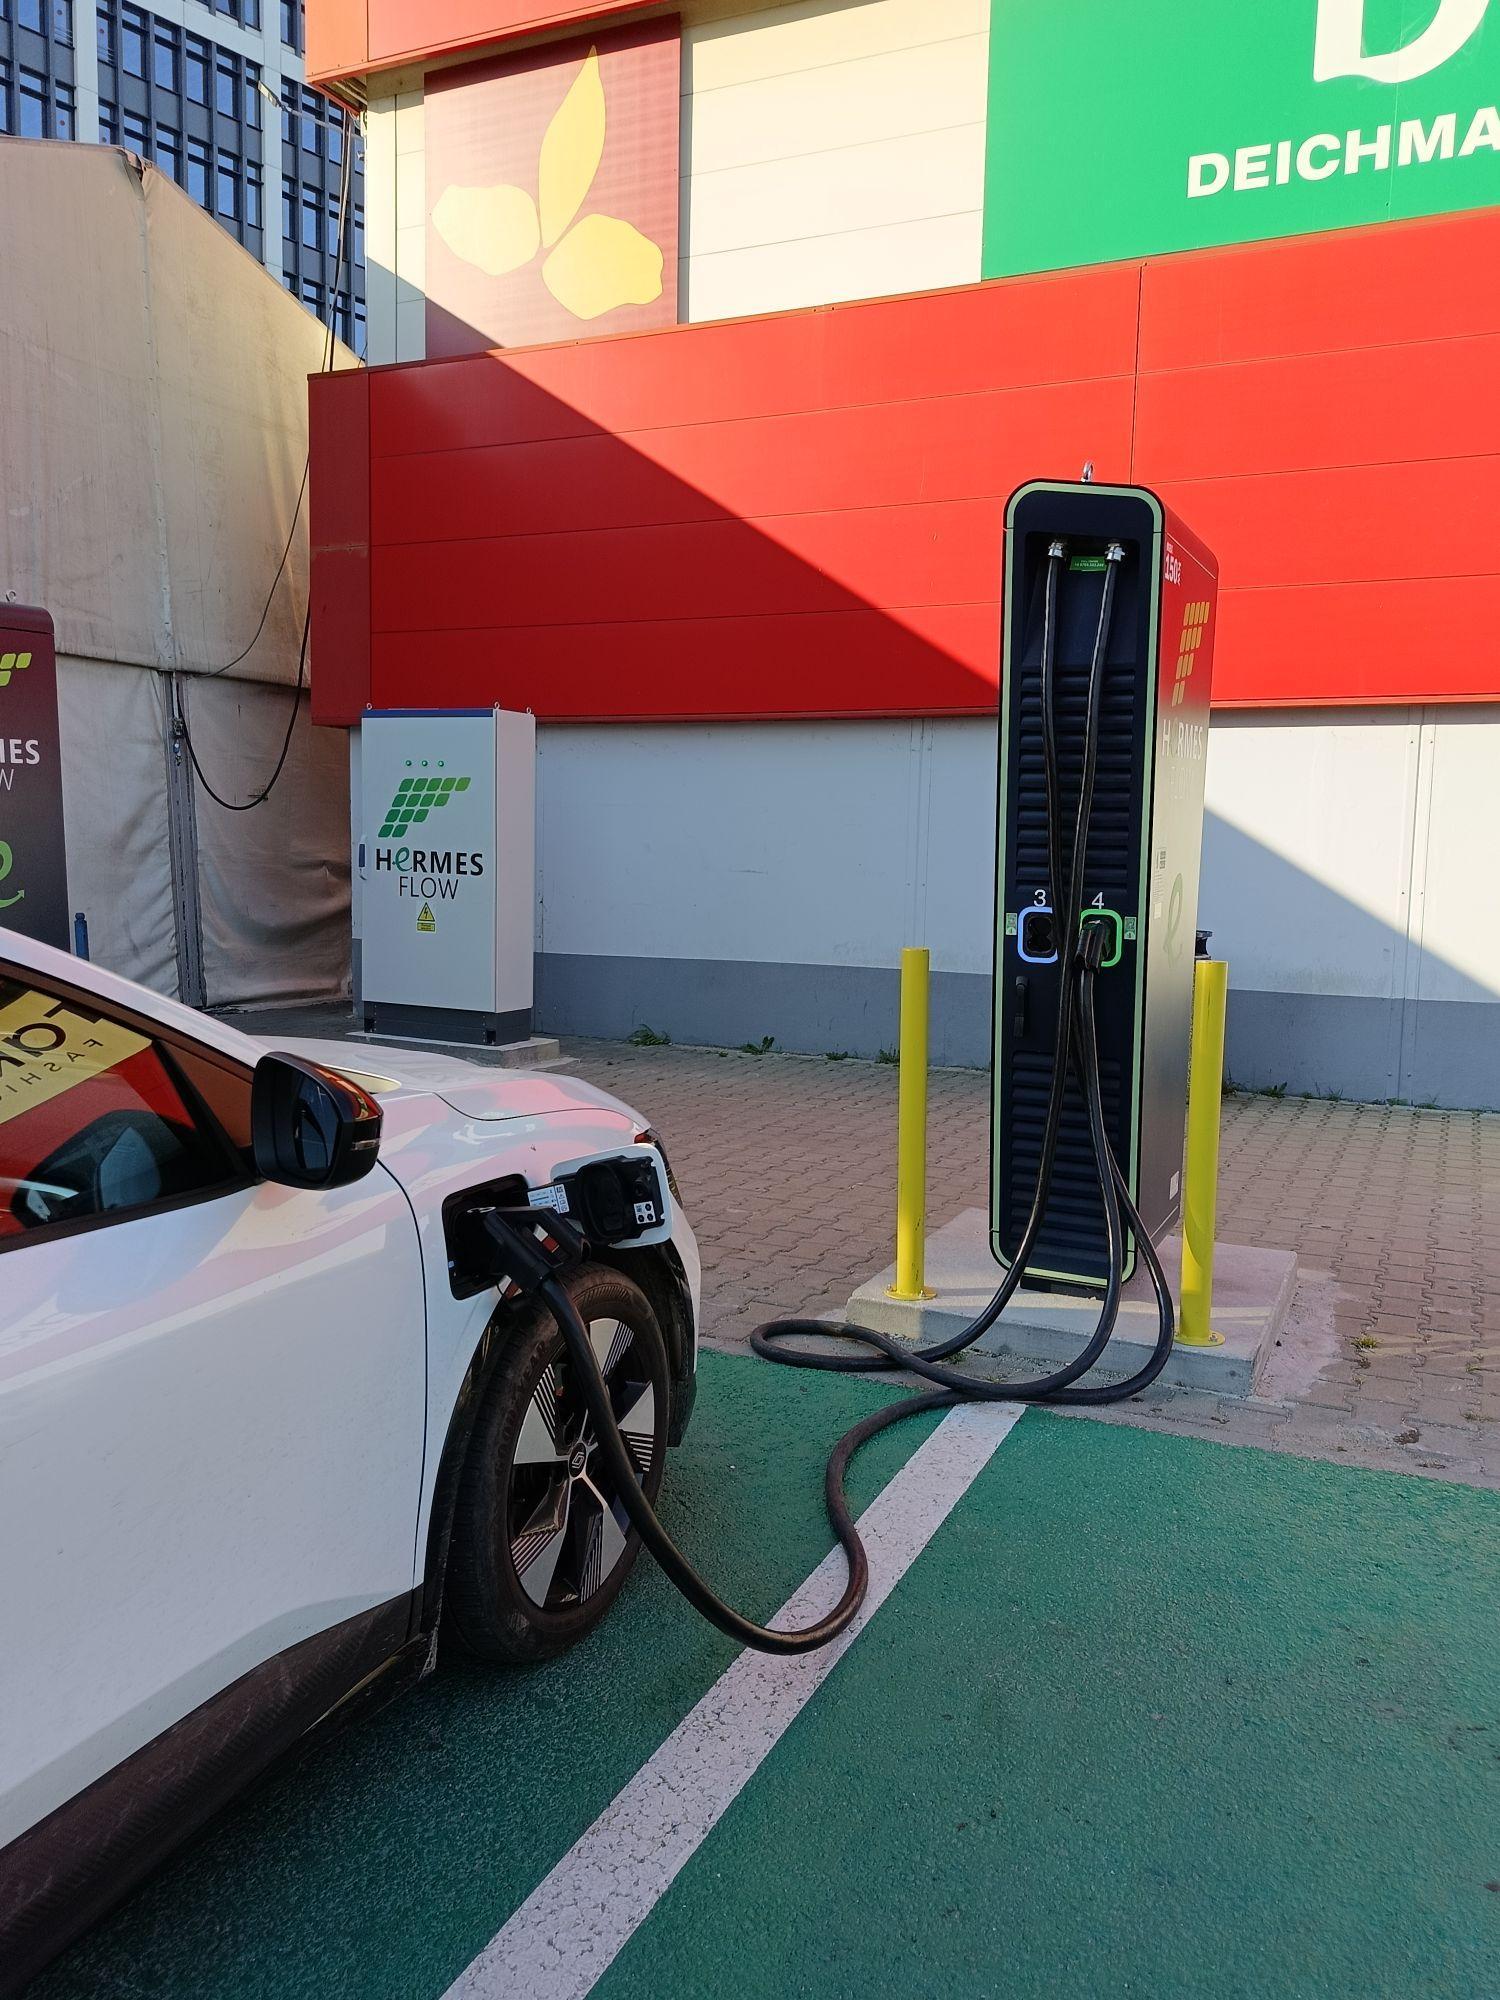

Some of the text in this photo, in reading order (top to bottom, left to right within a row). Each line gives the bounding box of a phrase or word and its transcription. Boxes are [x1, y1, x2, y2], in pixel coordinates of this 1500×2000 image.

[1187, 106, 1500, 198] DEICHMA
[399, 876, 460, 900] FLOW
[1033, 889, 1047, 907] 3
[1091, 891, 1105, 910] 4
